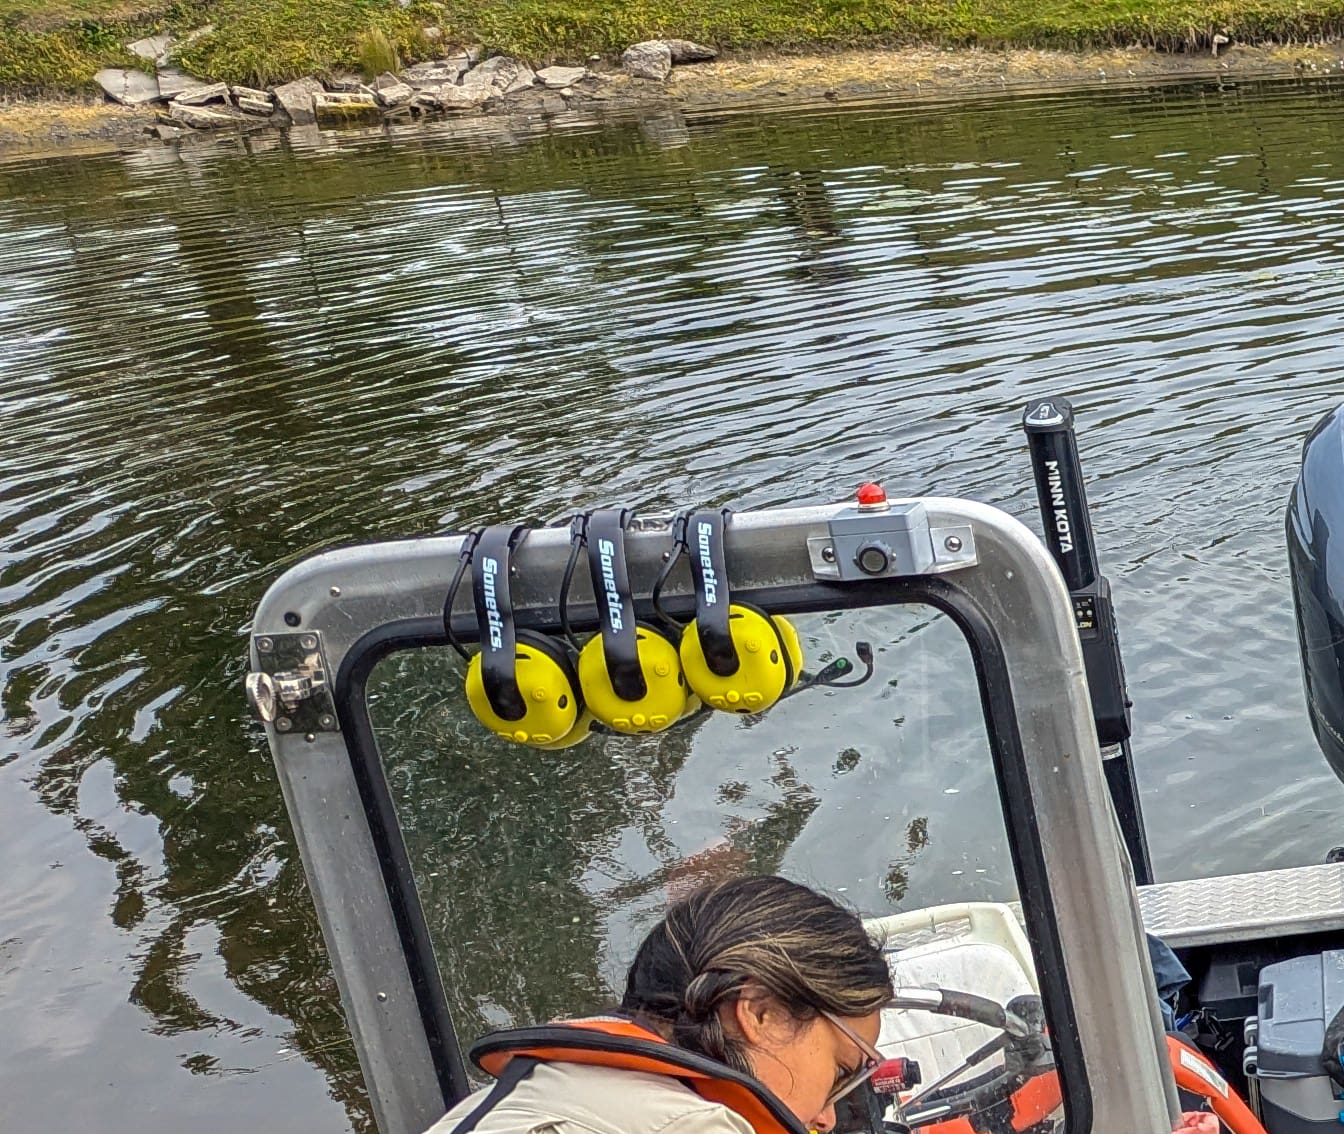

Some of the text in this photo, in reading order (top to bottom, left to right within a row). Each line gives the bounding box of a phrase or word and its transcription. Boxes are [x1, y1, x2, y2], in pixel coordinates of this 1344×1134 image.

[1045, 460, 1074, 554] MINN KOTA
[483, 556, 504, 649] Sonetics
[598, 539, 623, 630] Sonetics
[698, 522, 719, 604] Sonetics
